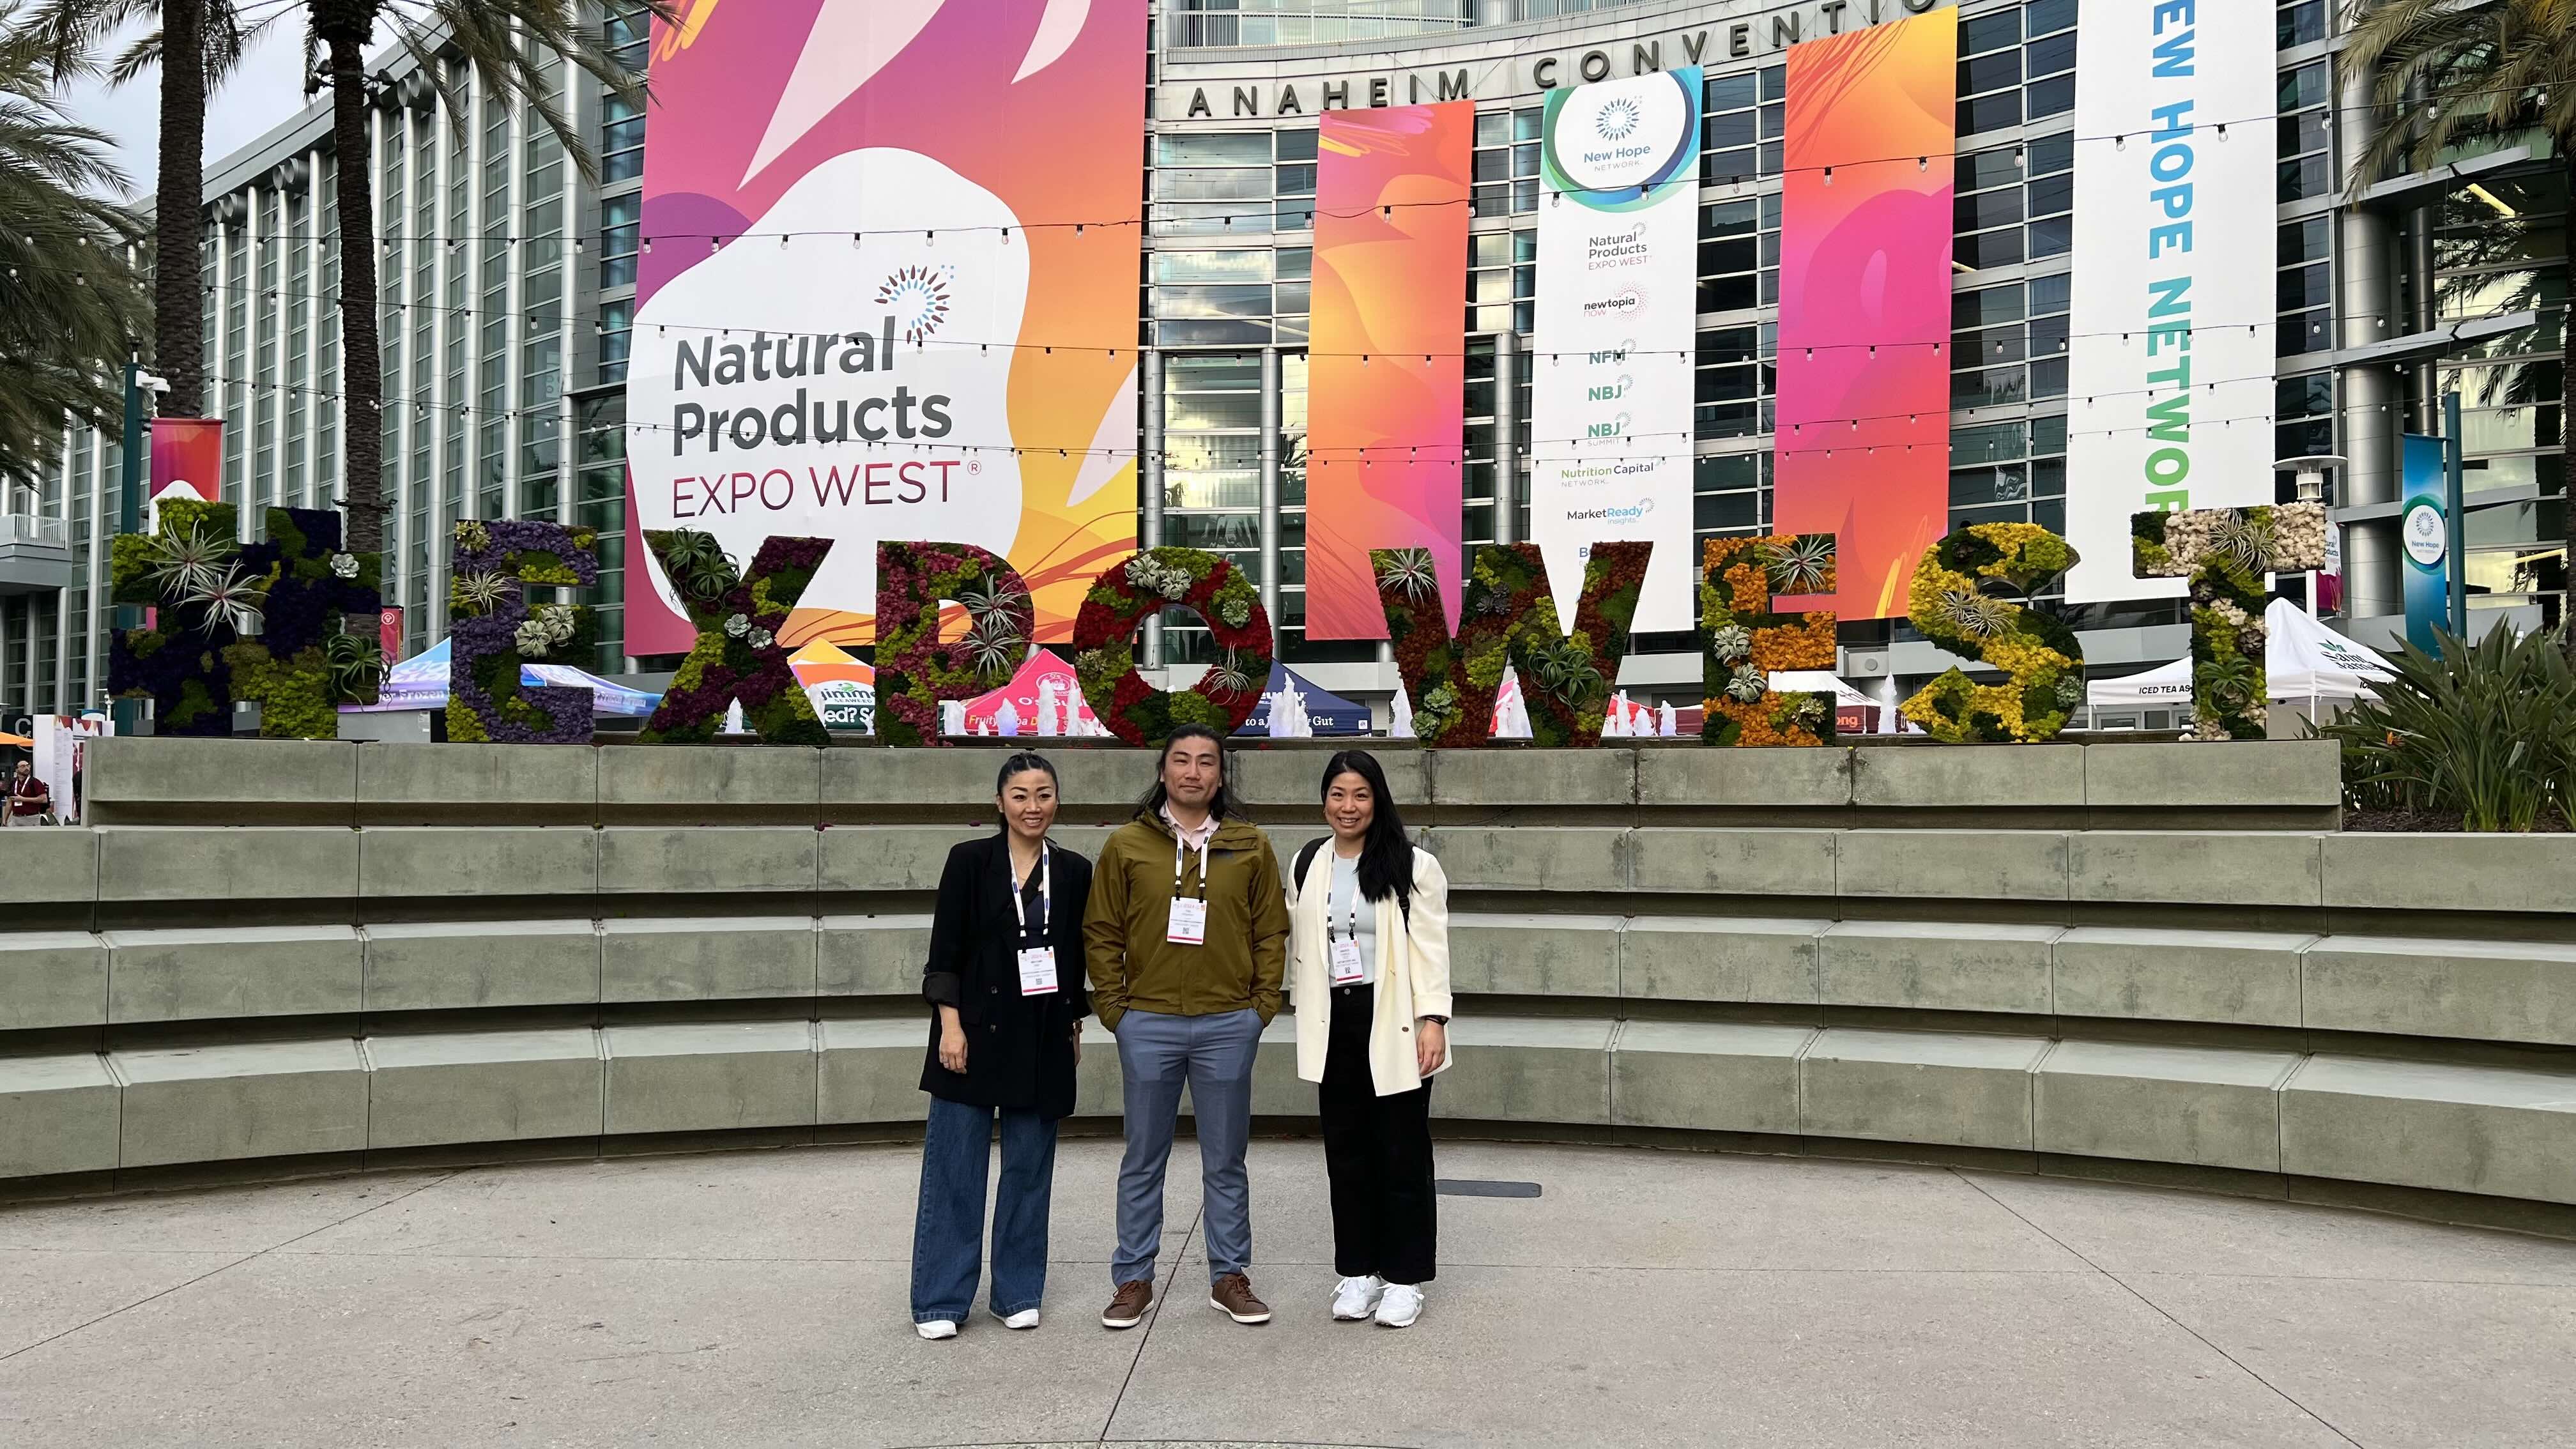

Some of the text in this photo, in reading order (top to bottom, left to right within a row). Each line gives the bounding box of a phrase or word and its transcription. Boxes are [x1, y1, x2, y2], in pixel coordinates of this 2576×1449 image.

[2152, 0, 2195, 77] EW
[1188, 68, 1468, 117] ANAHEIM
[1584, 145, 1651, 163] New Hope
[1594, 160, 1639, 172] NETWORK
[2149, 99, 2194, 259] HOPE
[1589, 231, 1637, 247] Natural
[1589, 243, 1647, 259] Products
[1588, 256, 1648, 270] EXPO WEST
[1584, 296, 1635, 310] newtopia
[673, 315, 896, 391] Natural
[1589, 349, 1626, 364] NFM
[1588, 385, 1622, 401] NBJ
[673, 385, 953, 457] Products
[1588, 422, 1620, 438] NBJ
[673, 468, 794, 519] EXPO
[399, 689, 445, 701] Frozen
[2139, 686, 2159, 694] ICED
[1312, 716, 1334, 726] Gut
